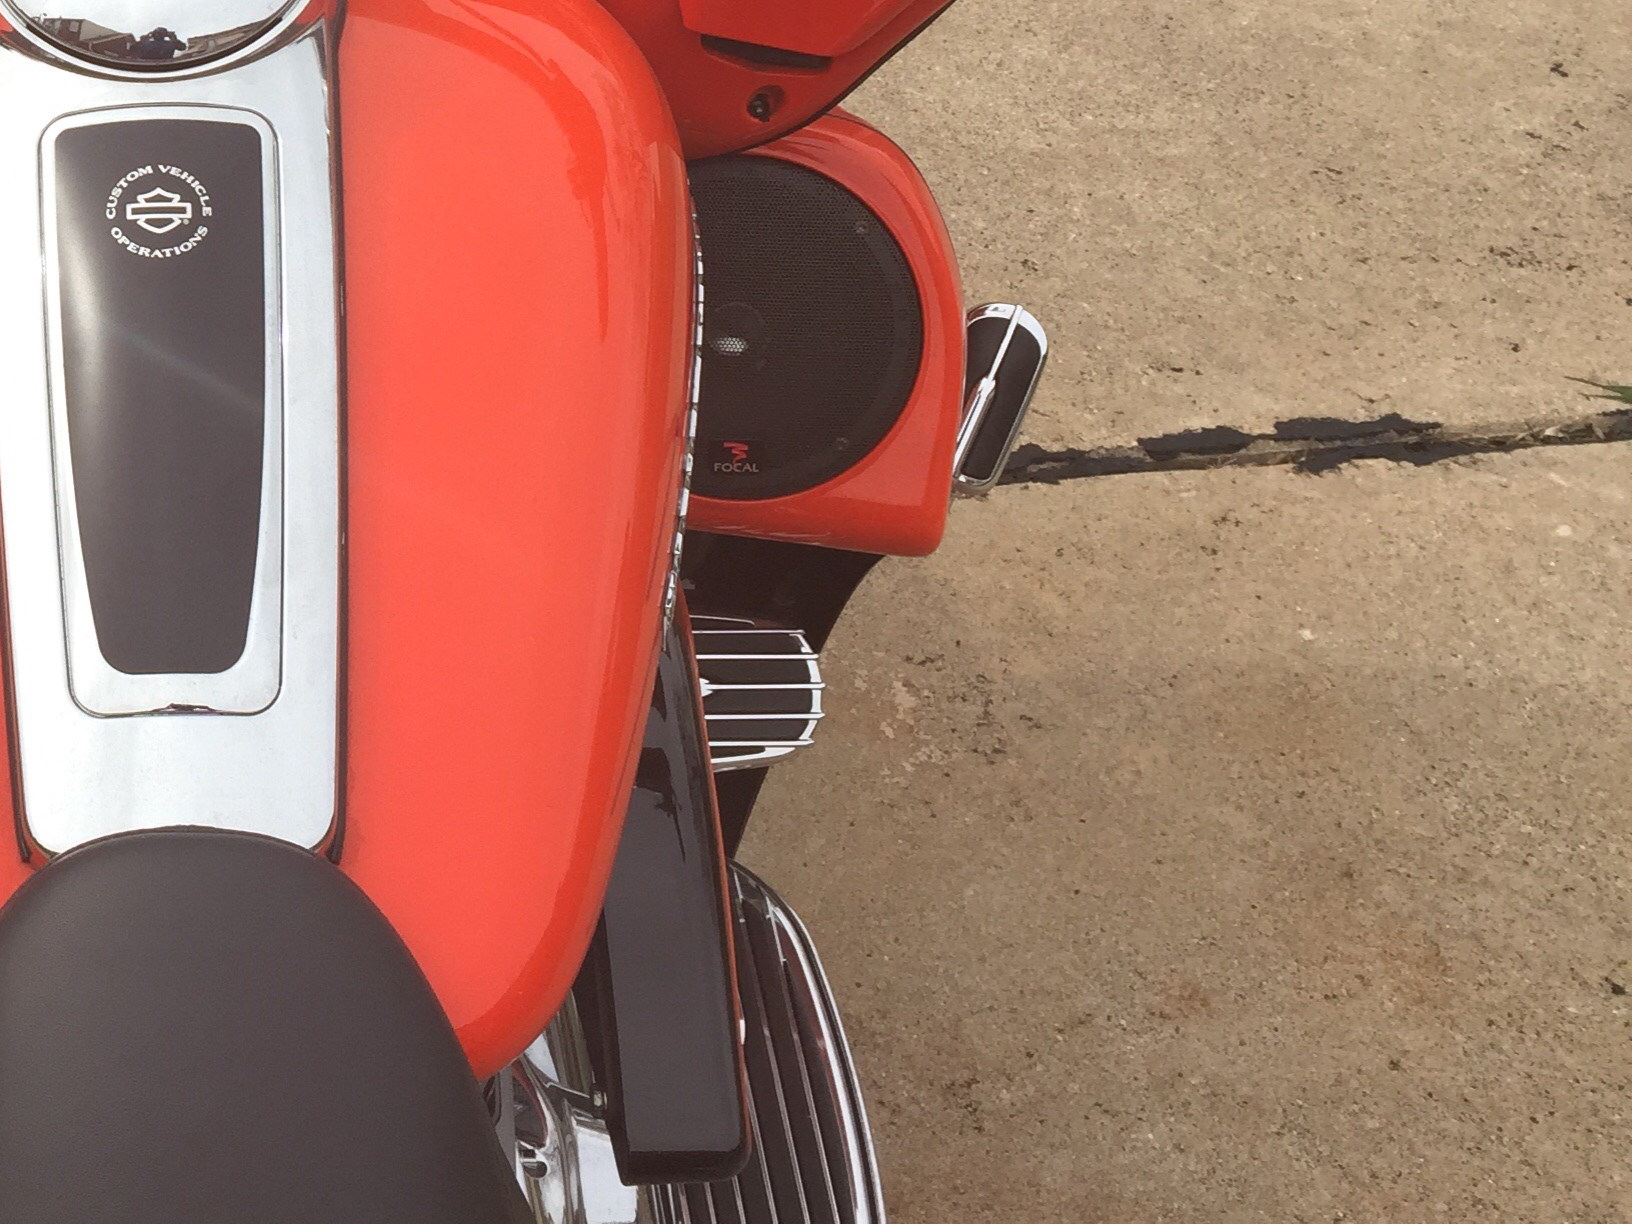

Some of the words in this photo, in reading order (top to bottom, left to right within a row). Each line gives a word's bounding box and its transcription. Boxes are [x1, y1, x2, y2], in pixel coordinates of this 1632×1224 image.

[106, 165, 154, 220] CUSTOM
[158, 164, 213, 217] VEHICLE
[110, 225, 209, 258] OPERATIONS
[713, 462, 760, 473] FOCAL
